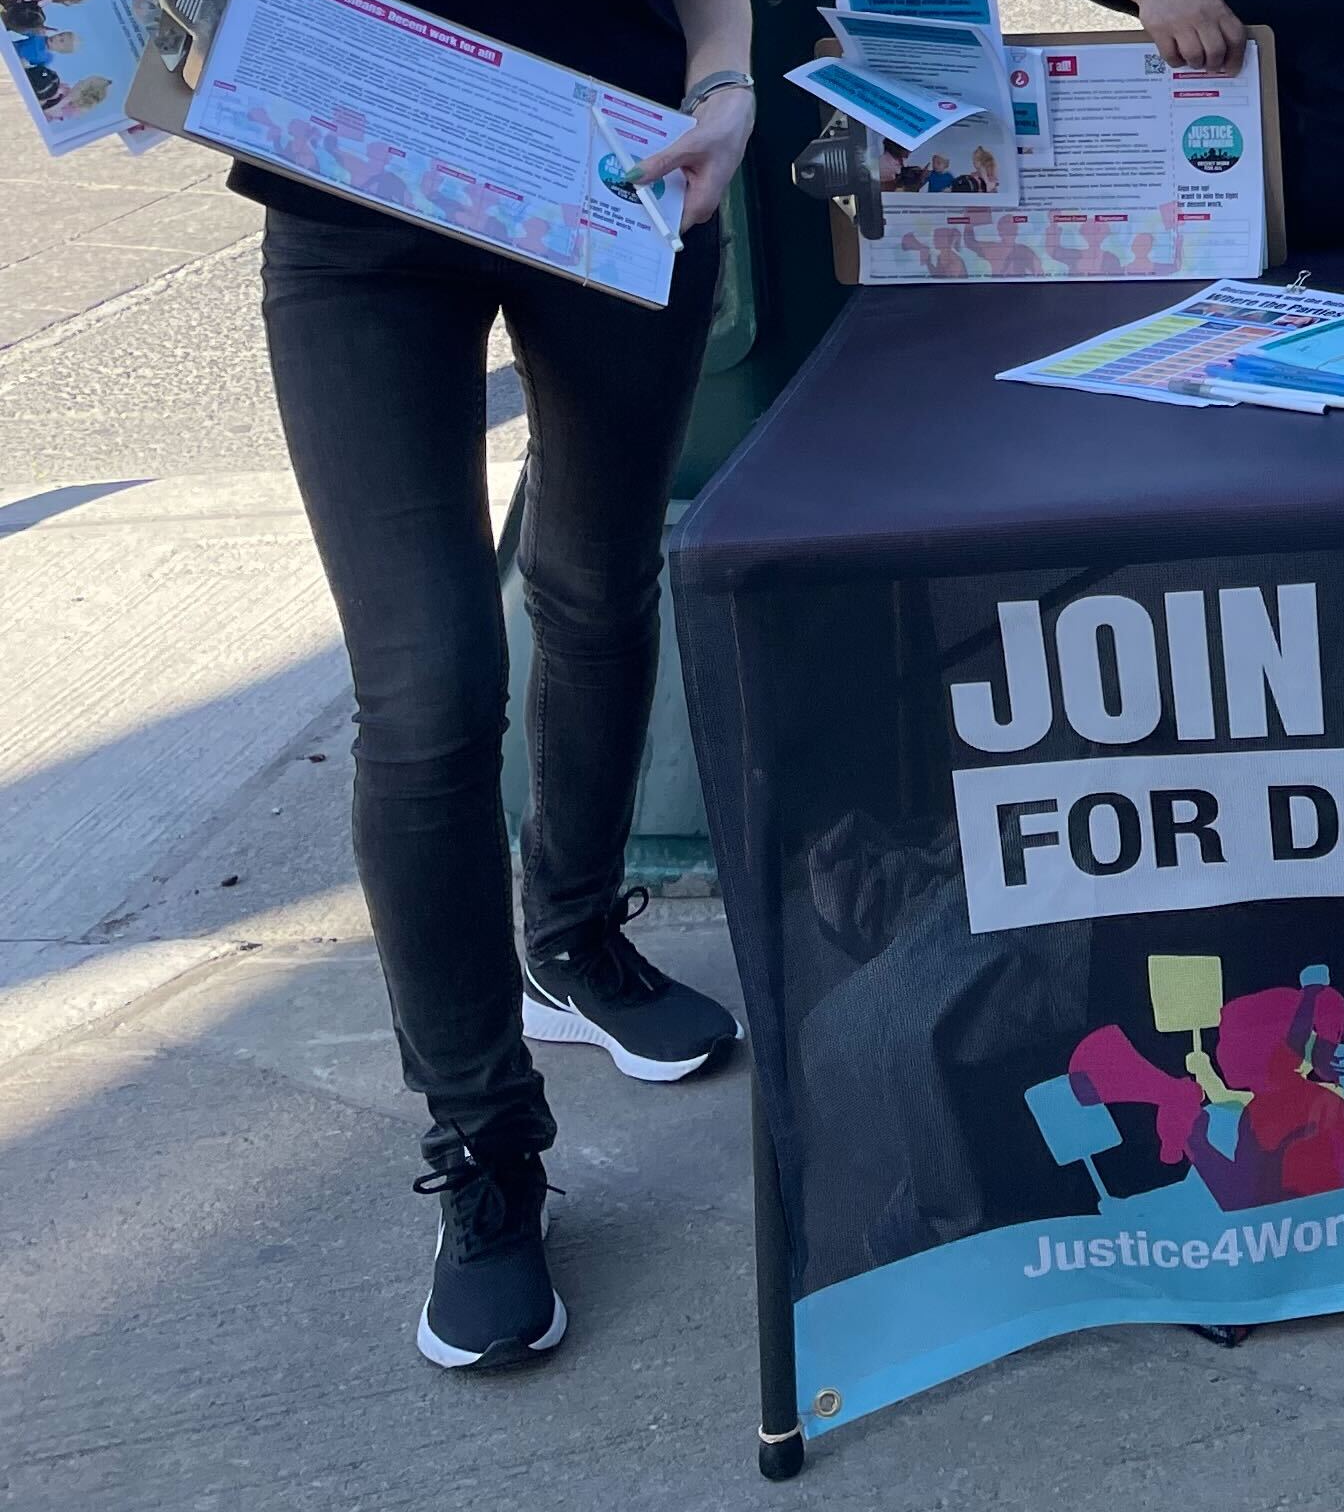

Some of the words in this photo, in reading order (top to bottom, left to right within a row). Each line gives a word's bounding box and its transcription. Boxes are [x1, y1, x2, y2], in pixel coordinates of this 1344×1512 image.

[387, 10, 428, 36] Decent
[429, 25, 458, 47] work
[458, 38, 476, 55] for
[1188, 124, 1234, 139] JUSTICE
[1205, 292, 1260, 307] Where
[1261, 298, 1286, 310] the
[950, 581, 1325, 753] JOIN
[995, 788, 1228, 887] FOR
